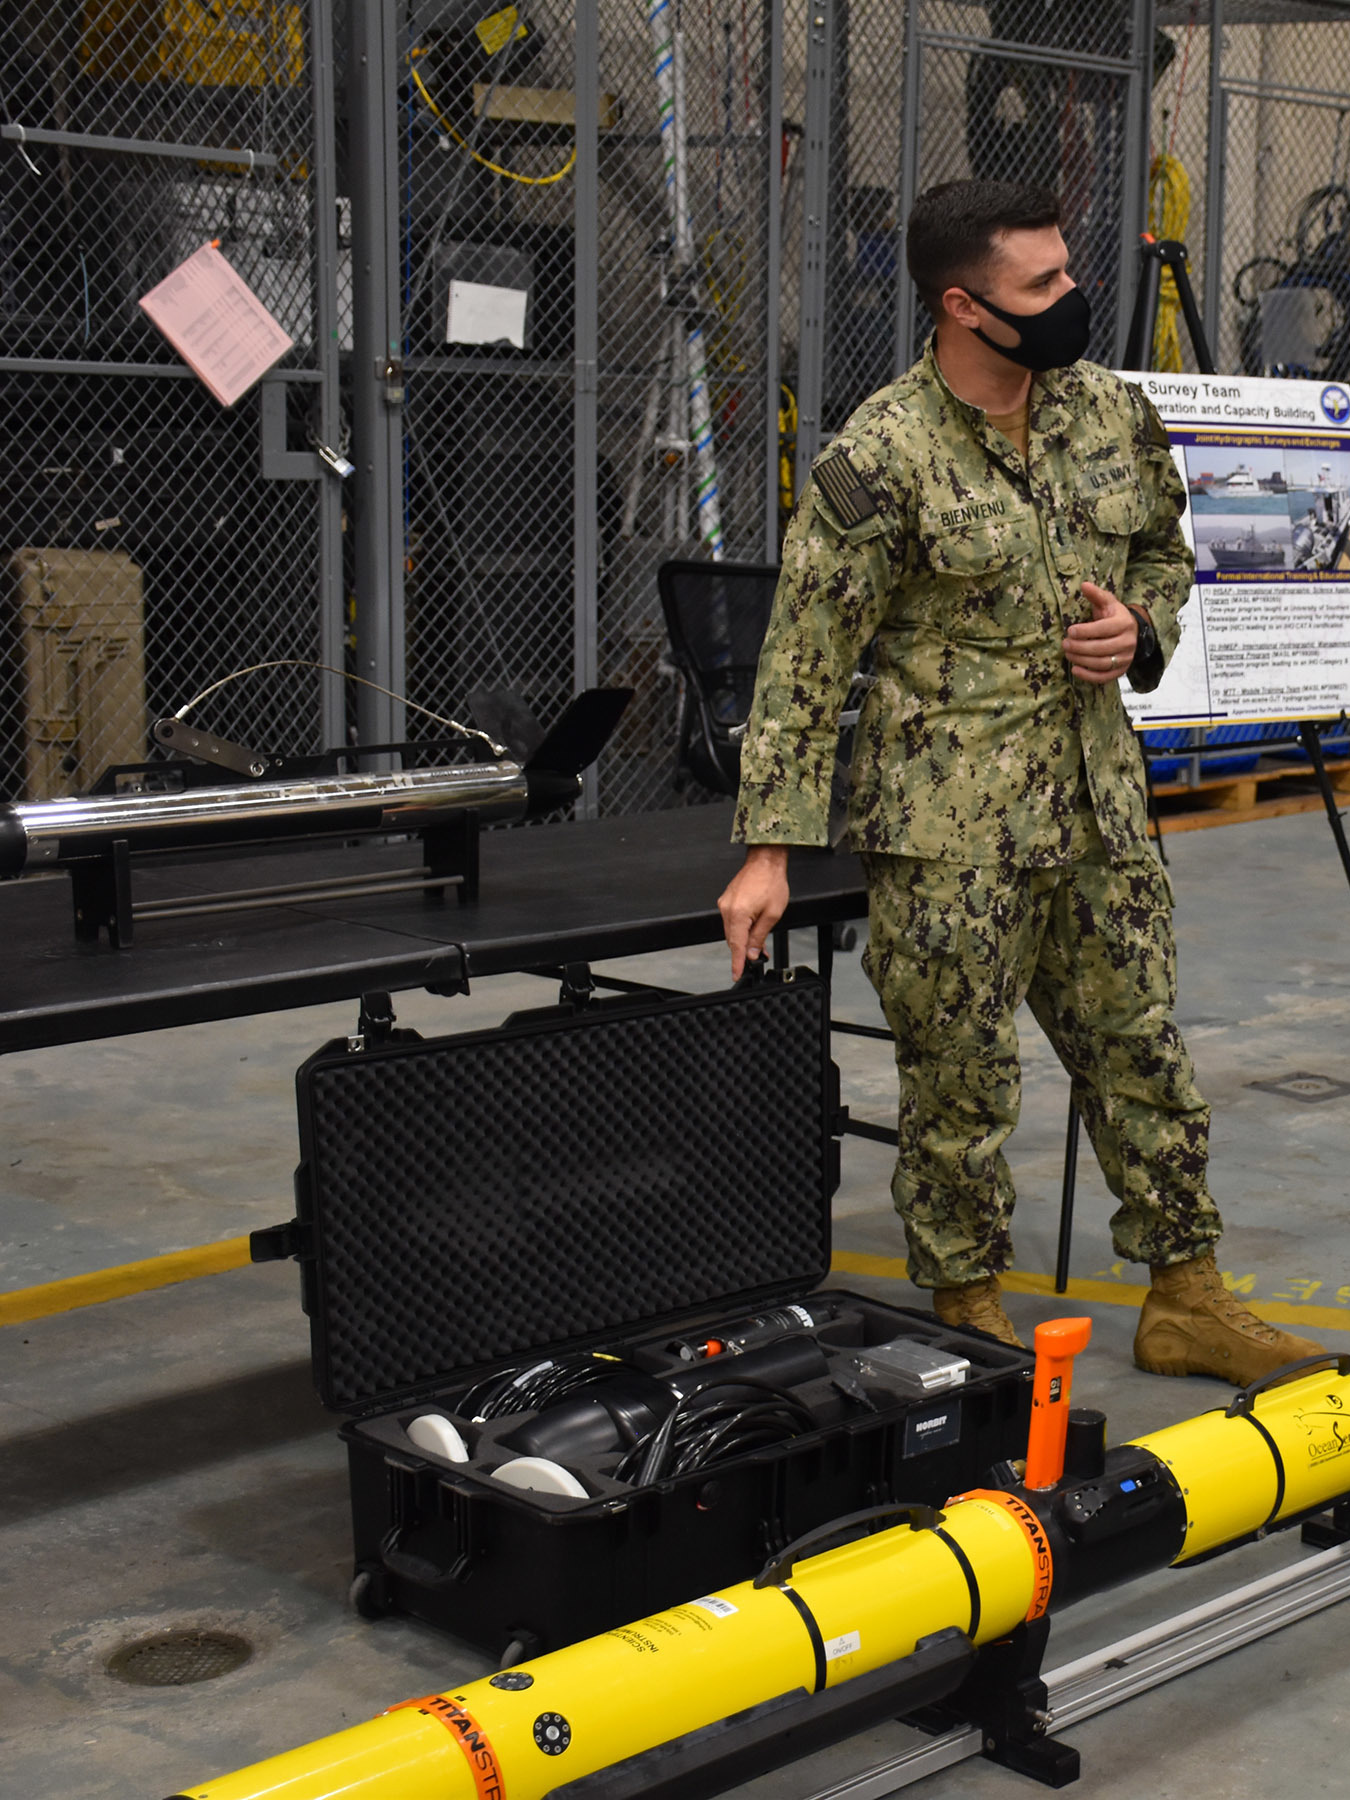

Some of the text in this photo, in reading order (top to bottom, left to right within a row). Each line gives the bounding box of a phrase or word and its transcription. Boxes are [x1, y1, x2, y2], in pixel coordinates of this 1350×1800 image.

[1148, 381, 1197, 399] Survey
[1202, 384, 1240, 398] Team
[1201, 405, 1221, 415] and
[1224, 405, 1271, 419] Capacity
[1274, 407, 1315, 421] Building
[1089, 464, 1133, 490] U.S. NAVY
[941, 502, 1006, 526] BIENVENU
[916, 1415, 948, 1433] NORBIT
